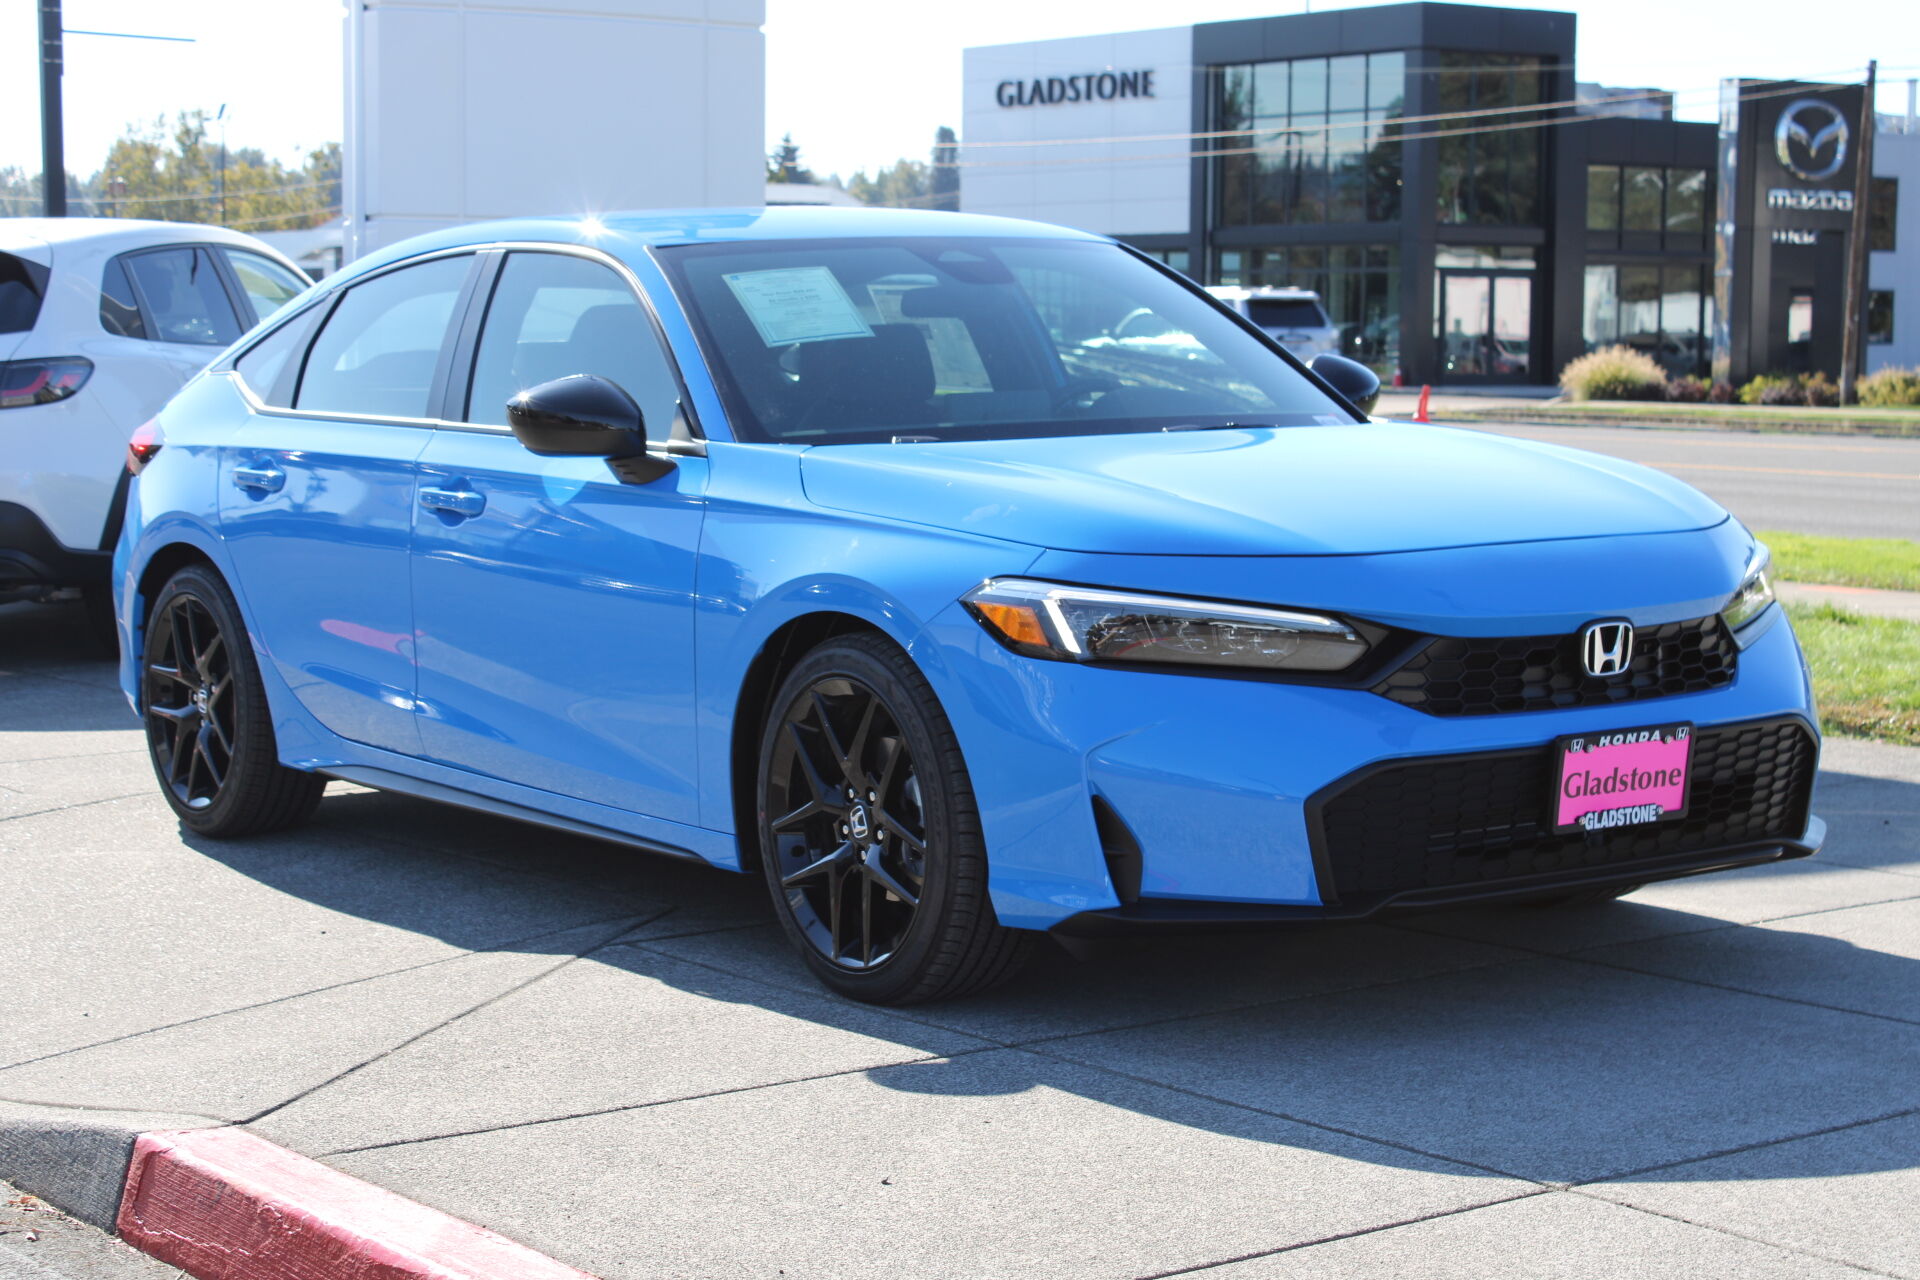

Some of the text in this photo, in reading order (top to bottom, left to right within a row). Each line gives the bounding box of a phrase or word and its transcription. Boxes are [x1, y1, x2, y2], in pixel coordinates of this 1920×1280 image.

[996, 70, 1155, 107] GLADSTONE
[1600, 730, 1661, 747] HONDA
[1564, 768, 1681, 798] Gladstone
[1585, 804, 1657, 830] GLADSTONE
